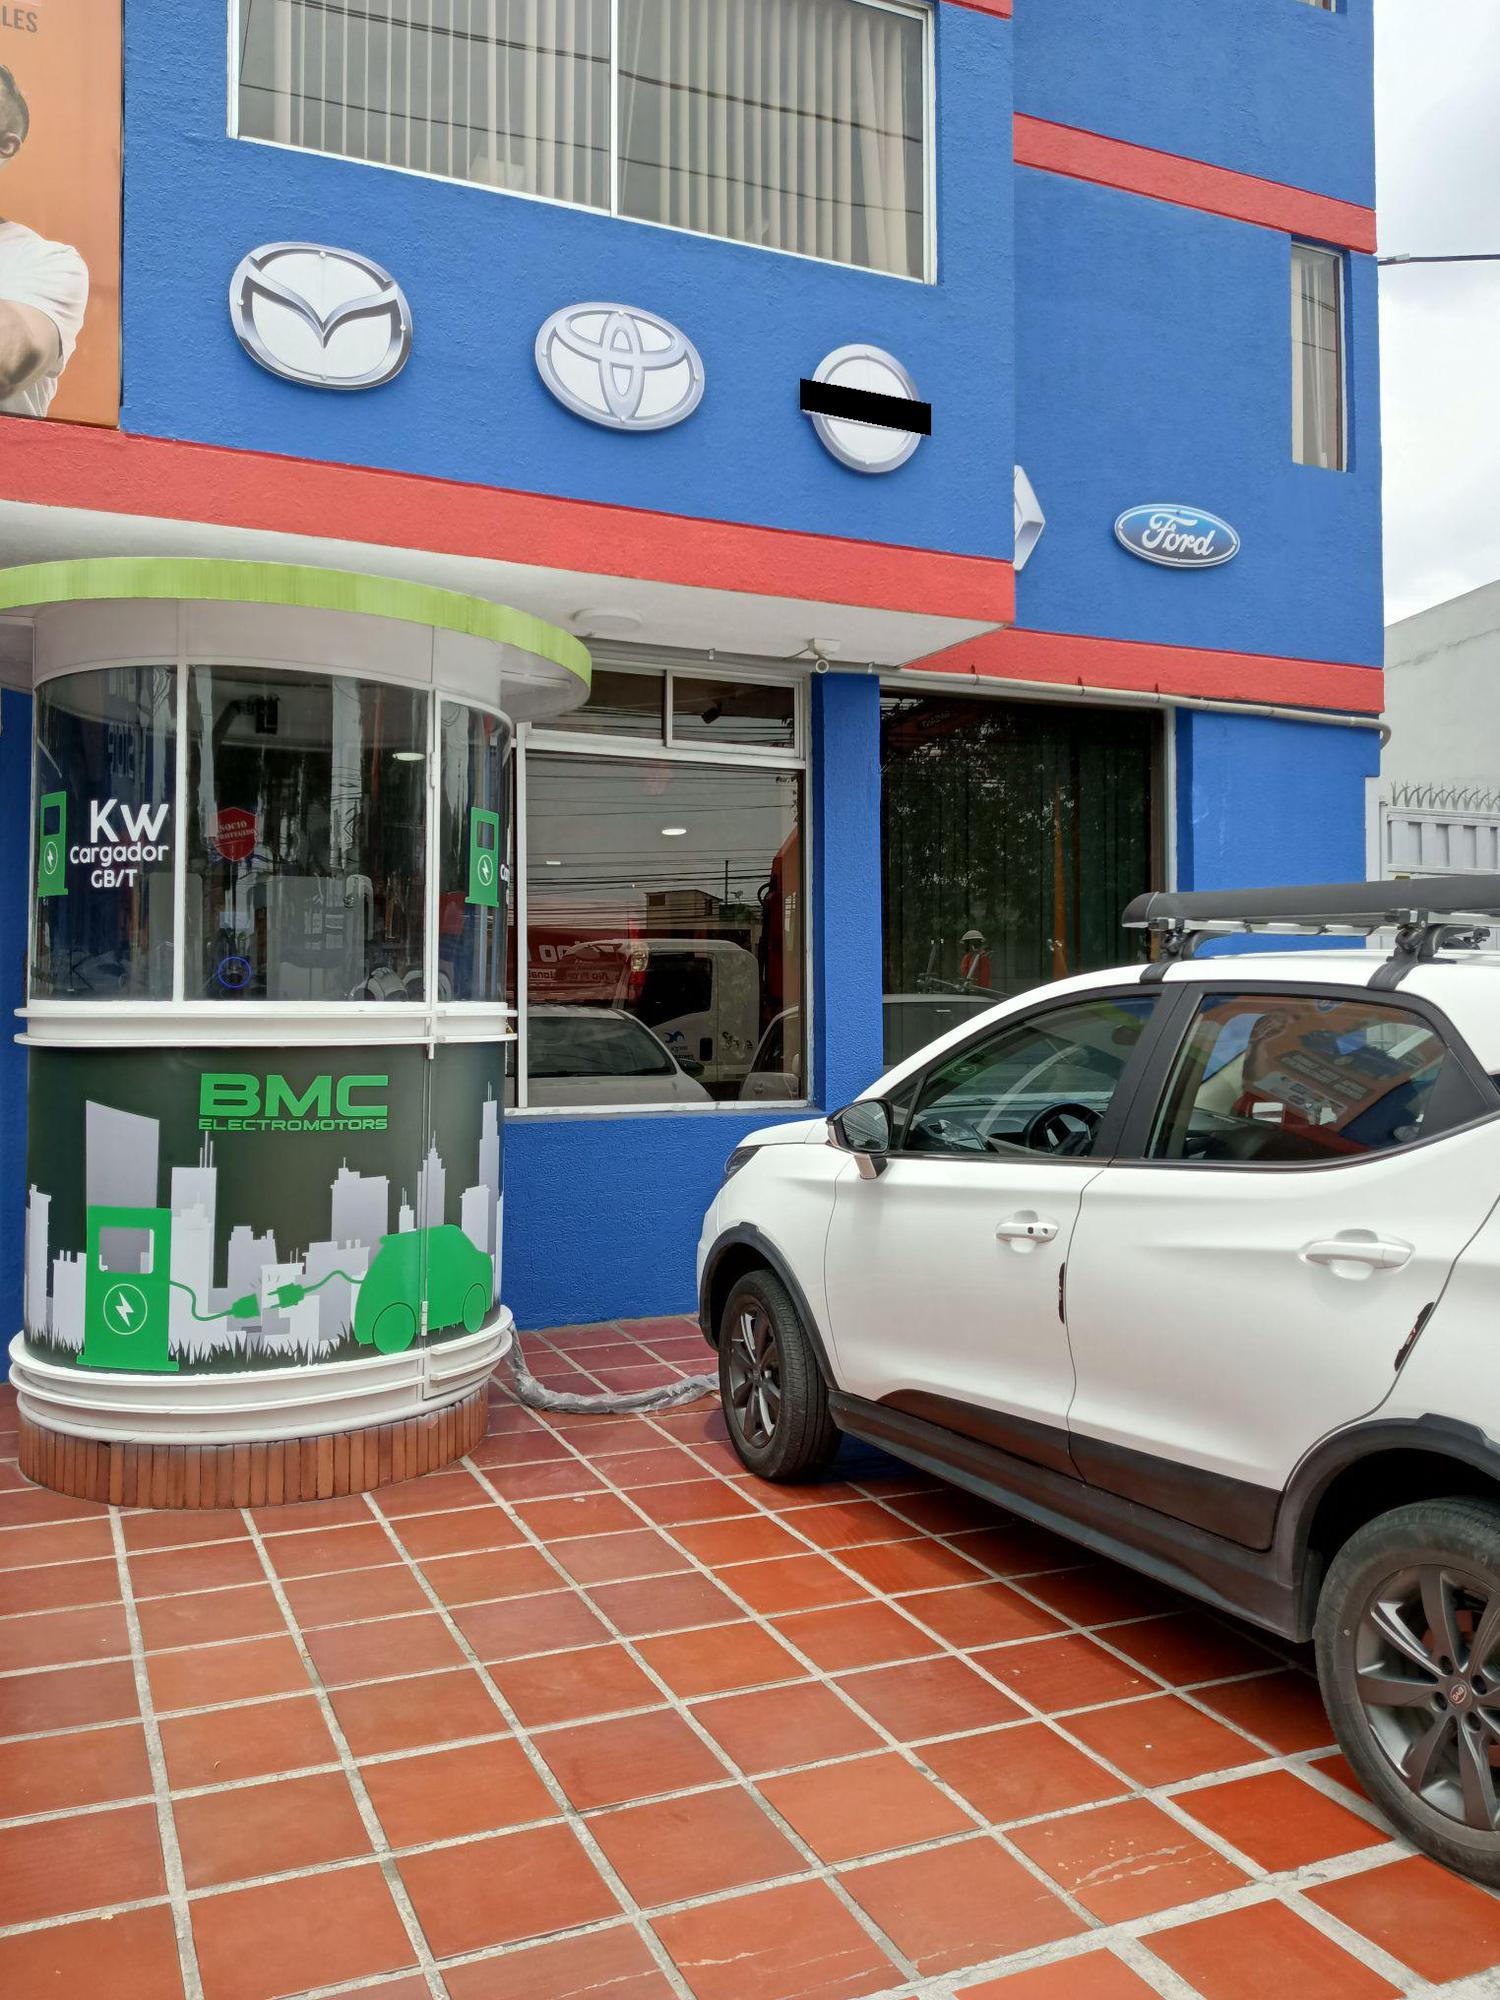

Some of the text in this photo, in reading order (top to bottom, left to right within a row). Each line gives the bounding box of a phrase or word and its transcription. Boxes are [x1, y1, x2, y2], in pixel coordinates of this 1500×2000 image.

[1141, 513, 1215, 556] Ford
[90, 868, 138, 889] GB/T
[199, 1072, 389, 1118] BMC
[198, 1118, 388, 1131] ELECTROMOTORS
